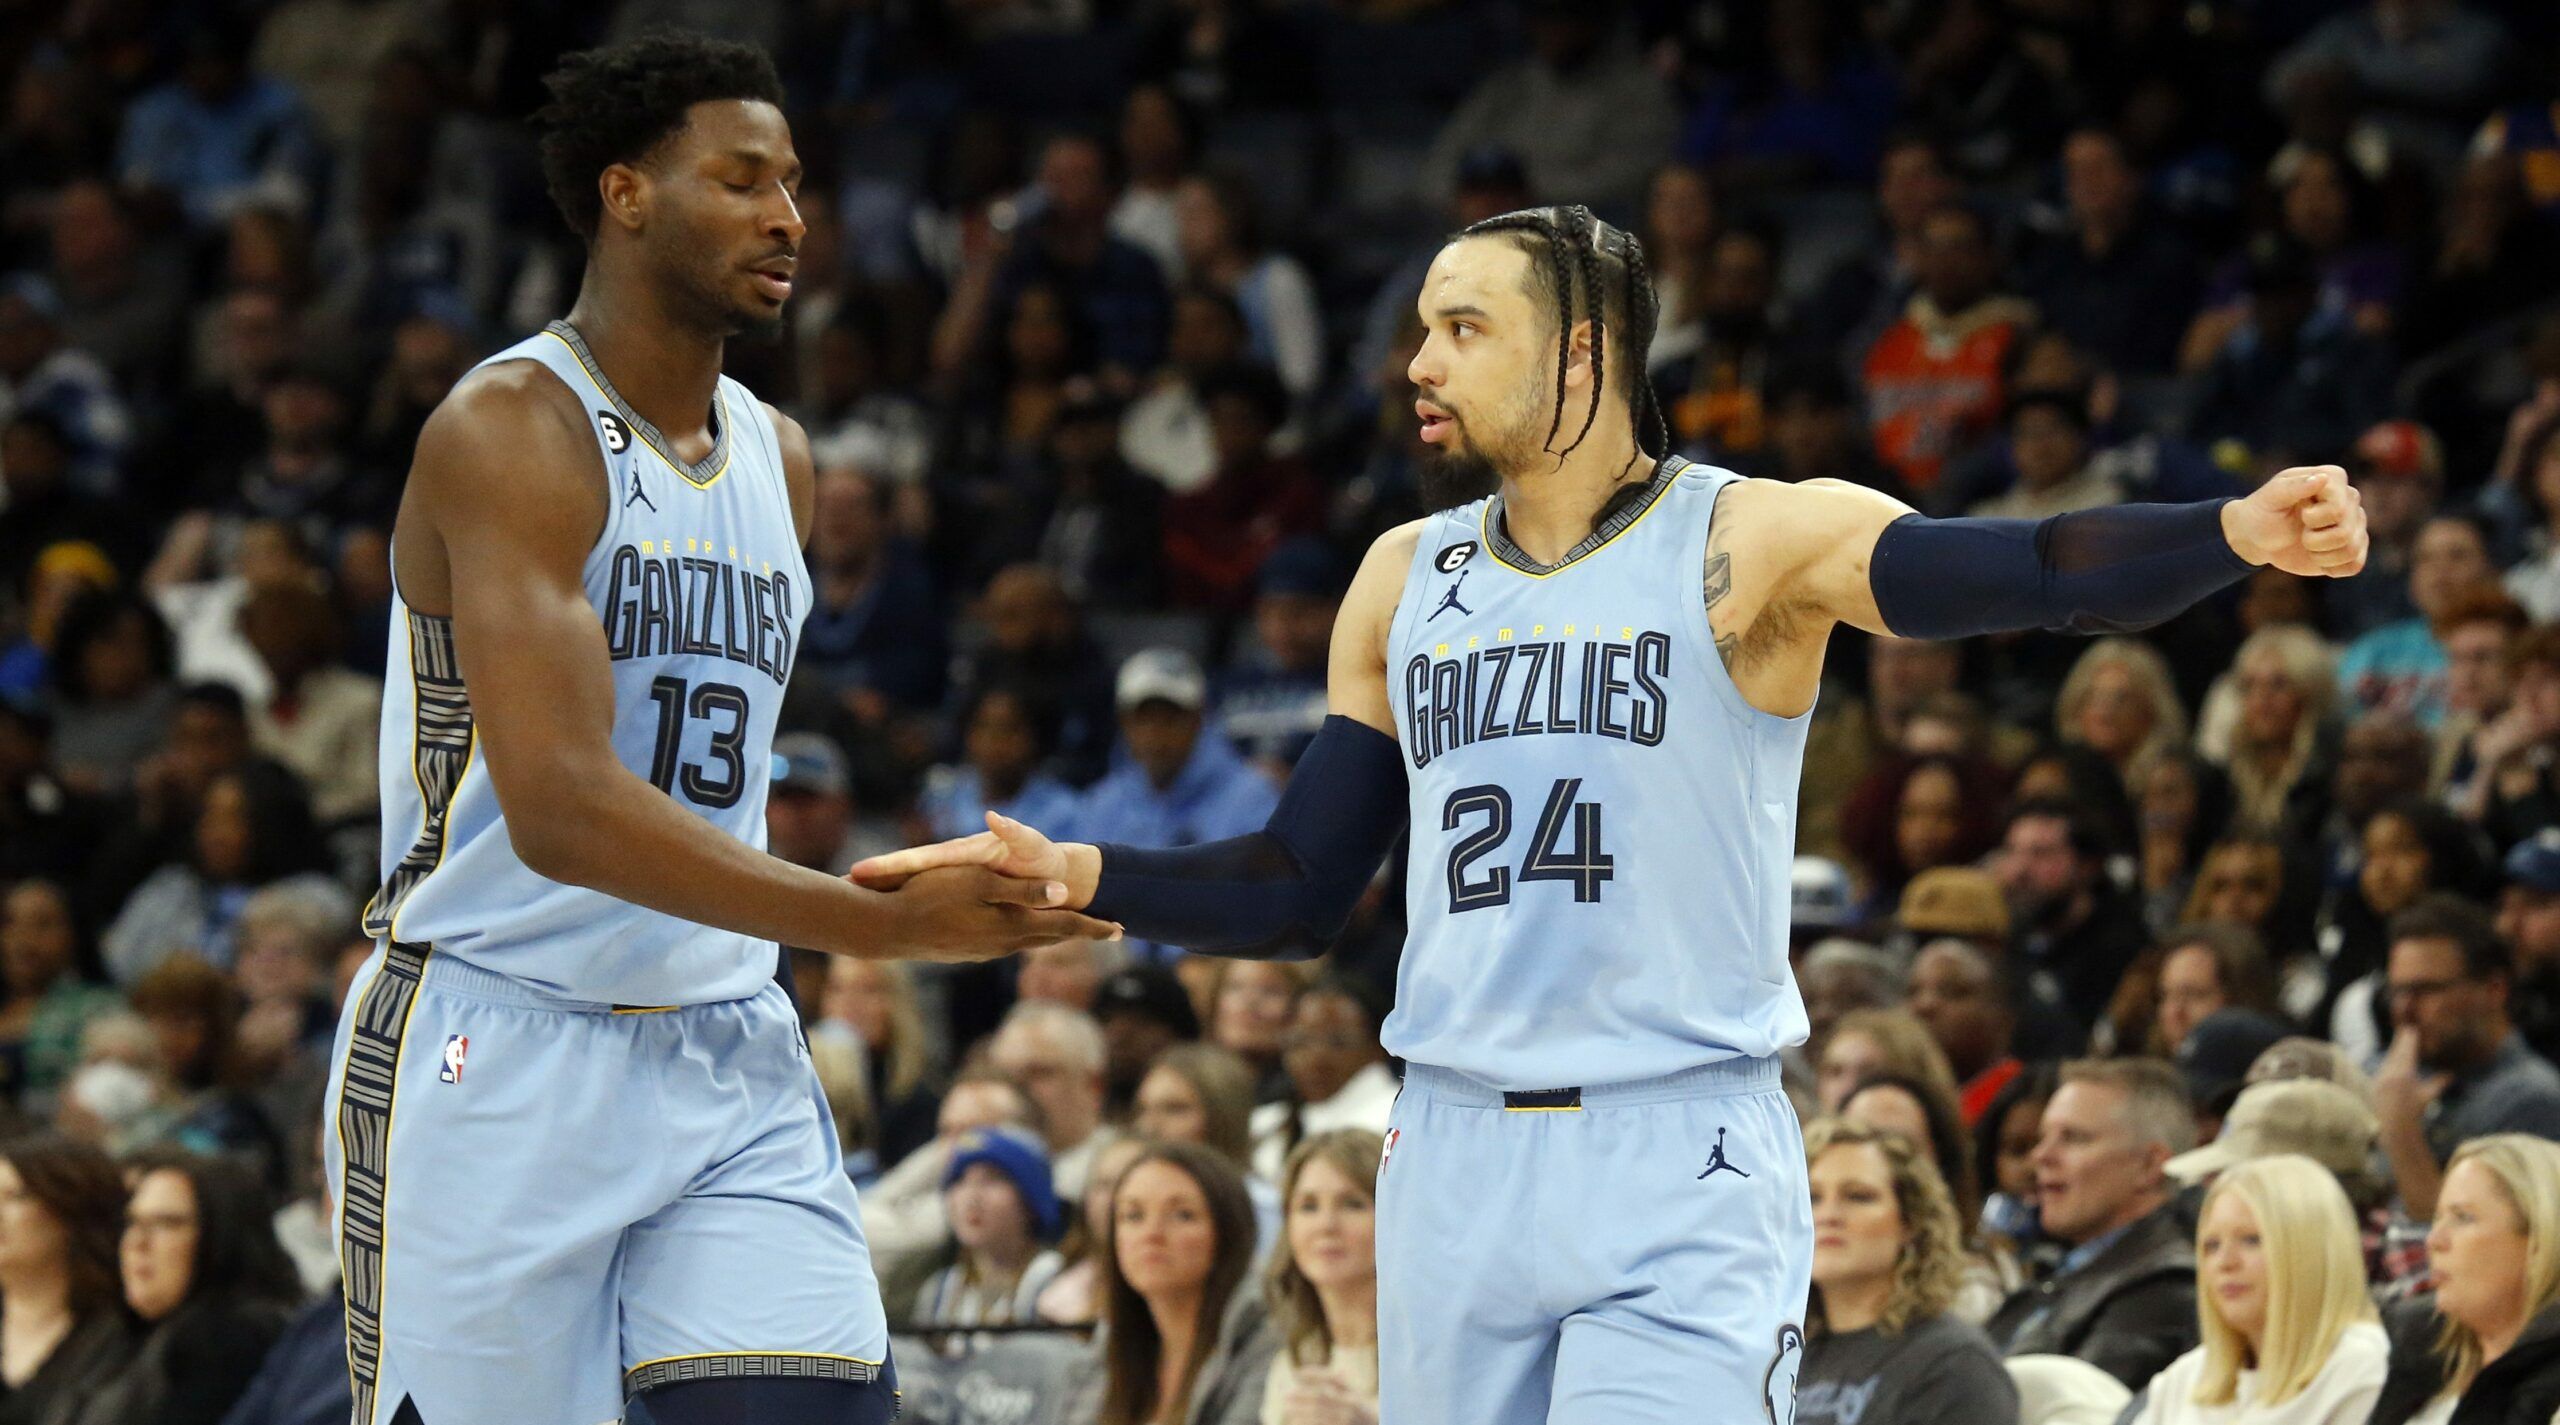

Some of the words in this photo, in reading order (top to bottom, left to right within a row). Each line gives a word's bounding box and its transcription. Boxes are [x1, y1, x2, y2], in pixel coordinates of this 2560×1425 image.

[600, 416, 624, 450] 6
[641, 538, 771, 577] MEMPHIS
[1443, 545, 1471, 570] 6
[605, 544, 791, 687] GRIZZLIES
[1434, 624, 1633, 658] MEMPHIS
[649, 675, 749, 809] 13
[1406, 630, 1671, 770] GRIZZLIES
[1441, 777, 1614, 914] 24
